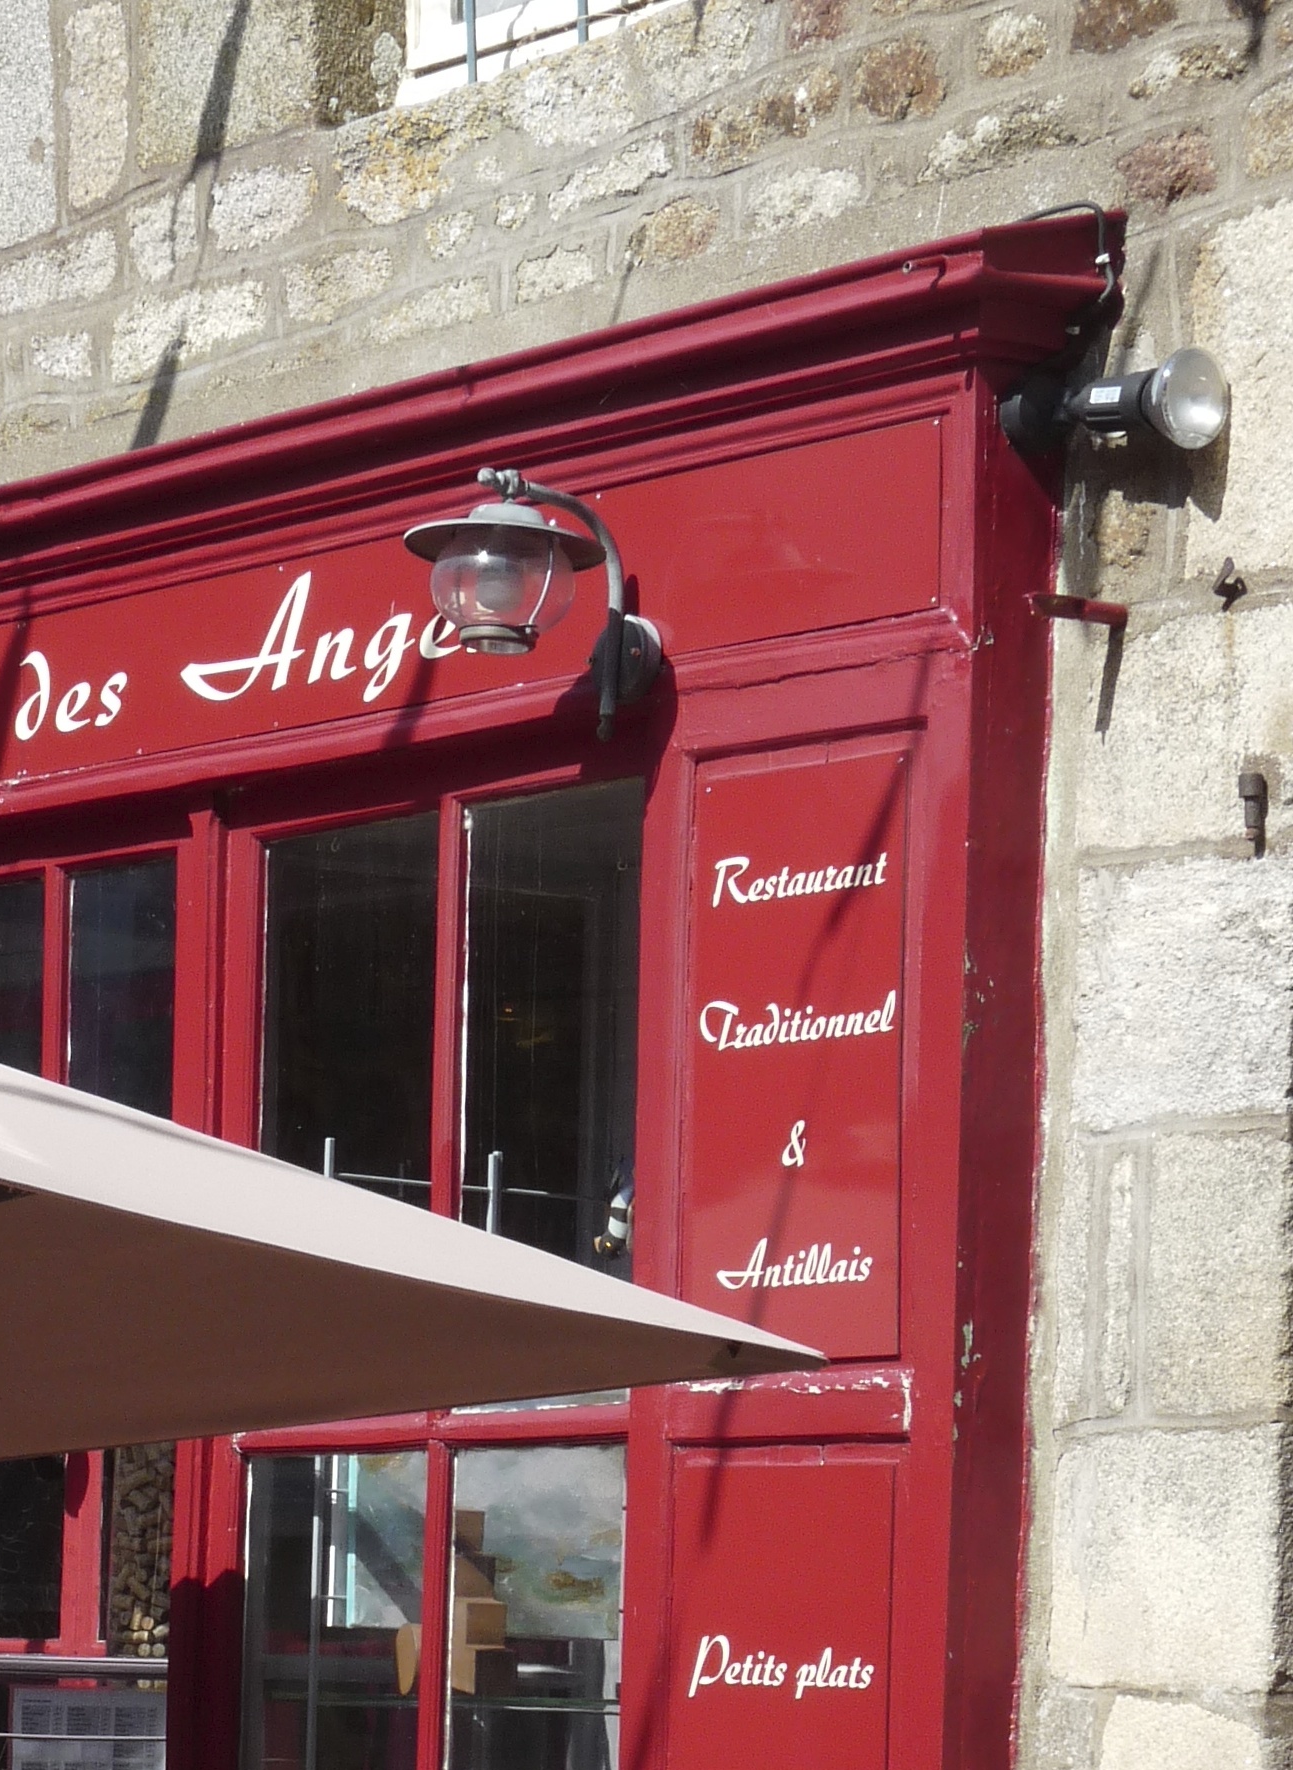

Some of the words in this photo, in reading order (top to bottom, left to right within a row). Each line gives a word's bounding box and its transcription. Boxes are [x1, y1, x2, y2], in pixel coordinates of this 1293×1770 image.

[14, 650, 128, 741] des
[180, 570, 480, 702] Ange
[712, 852, 887, 908] Restaurant
[699, 990, 896, 1051] Traditionnel
[781, 1119, 806, 1168] &
[716, 1237, 873, 1290] Antillais
[688, 1634, 788, 1698] Petits
[795, 1646, 875, 1700] plats
